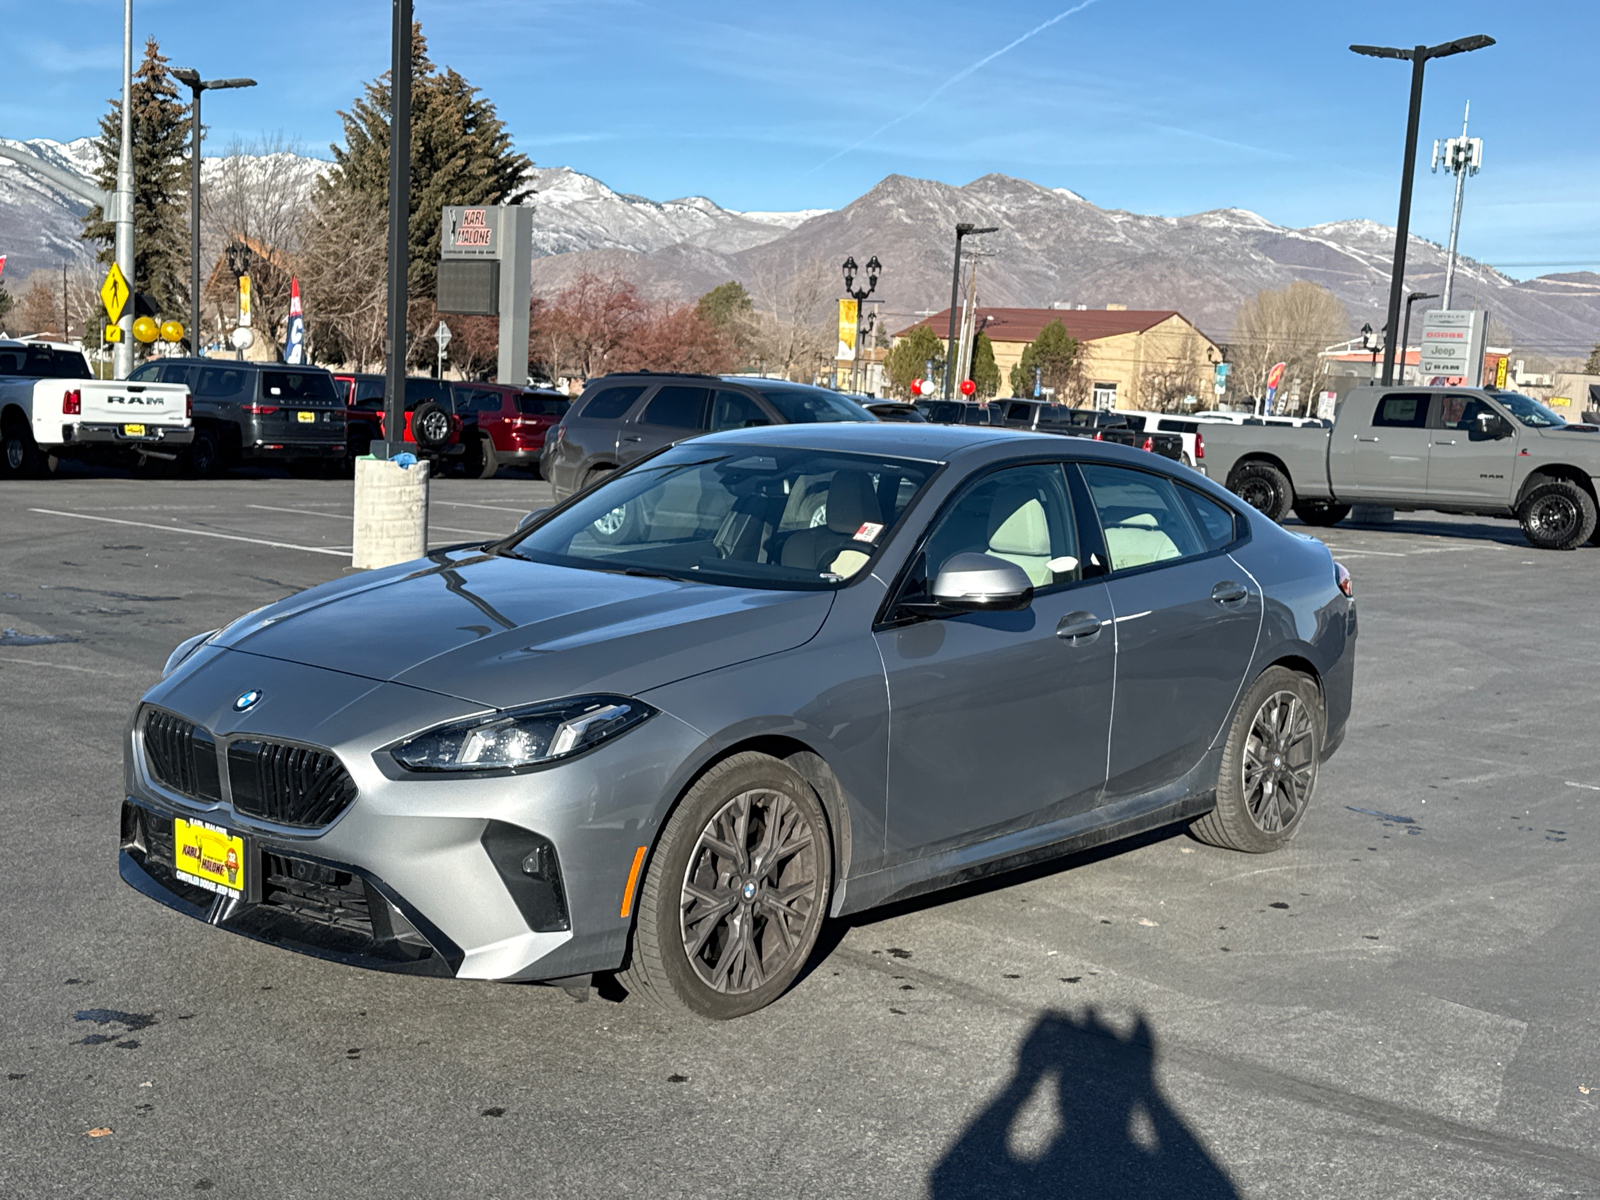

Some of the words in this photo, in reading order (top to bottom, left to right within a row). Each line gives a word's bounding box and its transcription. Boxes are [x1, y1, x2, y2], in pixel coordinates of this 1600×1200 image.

[463, 210, 485, 226] KARL
[456, 229, 491, 245] MALONE
[1431, 346, 1455, 356] Jeep
[107, 396, 164, 405] RAM
[189, 817, 204, 828] KARL
[205, 822, 227, 834] MALONE
[182, 844, 197, 859] KARL
[201, 858, 226, 876] MALONE
